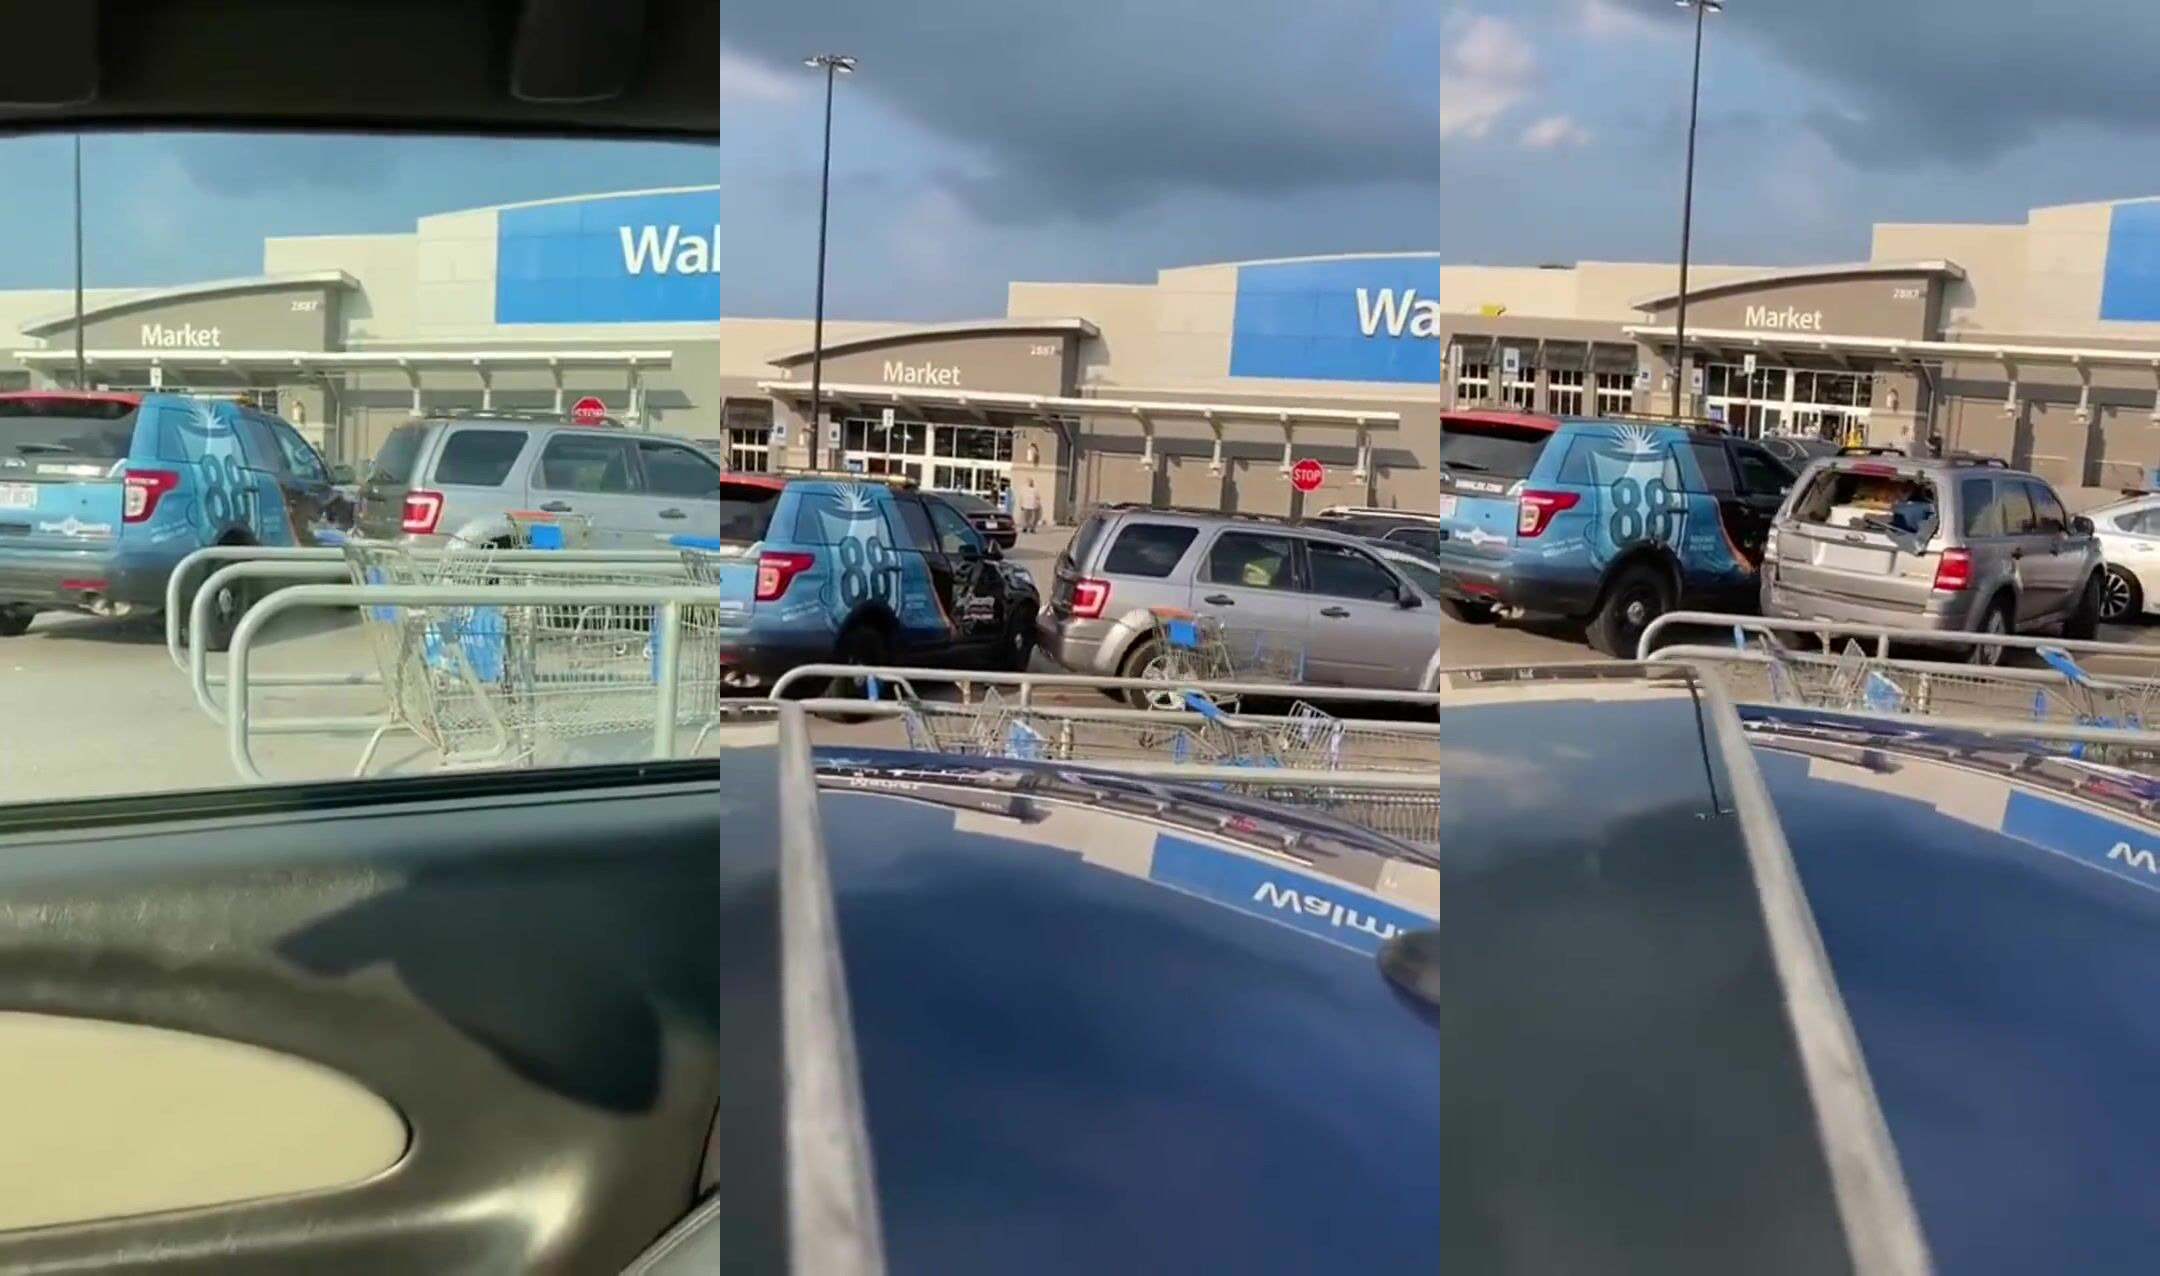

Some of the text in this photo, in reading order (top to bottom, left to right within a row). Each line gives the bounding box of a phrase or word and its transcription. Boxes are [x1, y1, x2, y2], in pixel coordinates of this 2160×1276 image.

[1355, 287, 1440, 338] Wa
[1744, 305, 1823, 331] Market
[140, 322, 221, 348] Market
[883, 360, 961, 386] Market
[1295, 468, 1320, 482] STOP
[1609, 476, 1672, 549] 88
[840, 535, 891, 609] 88
